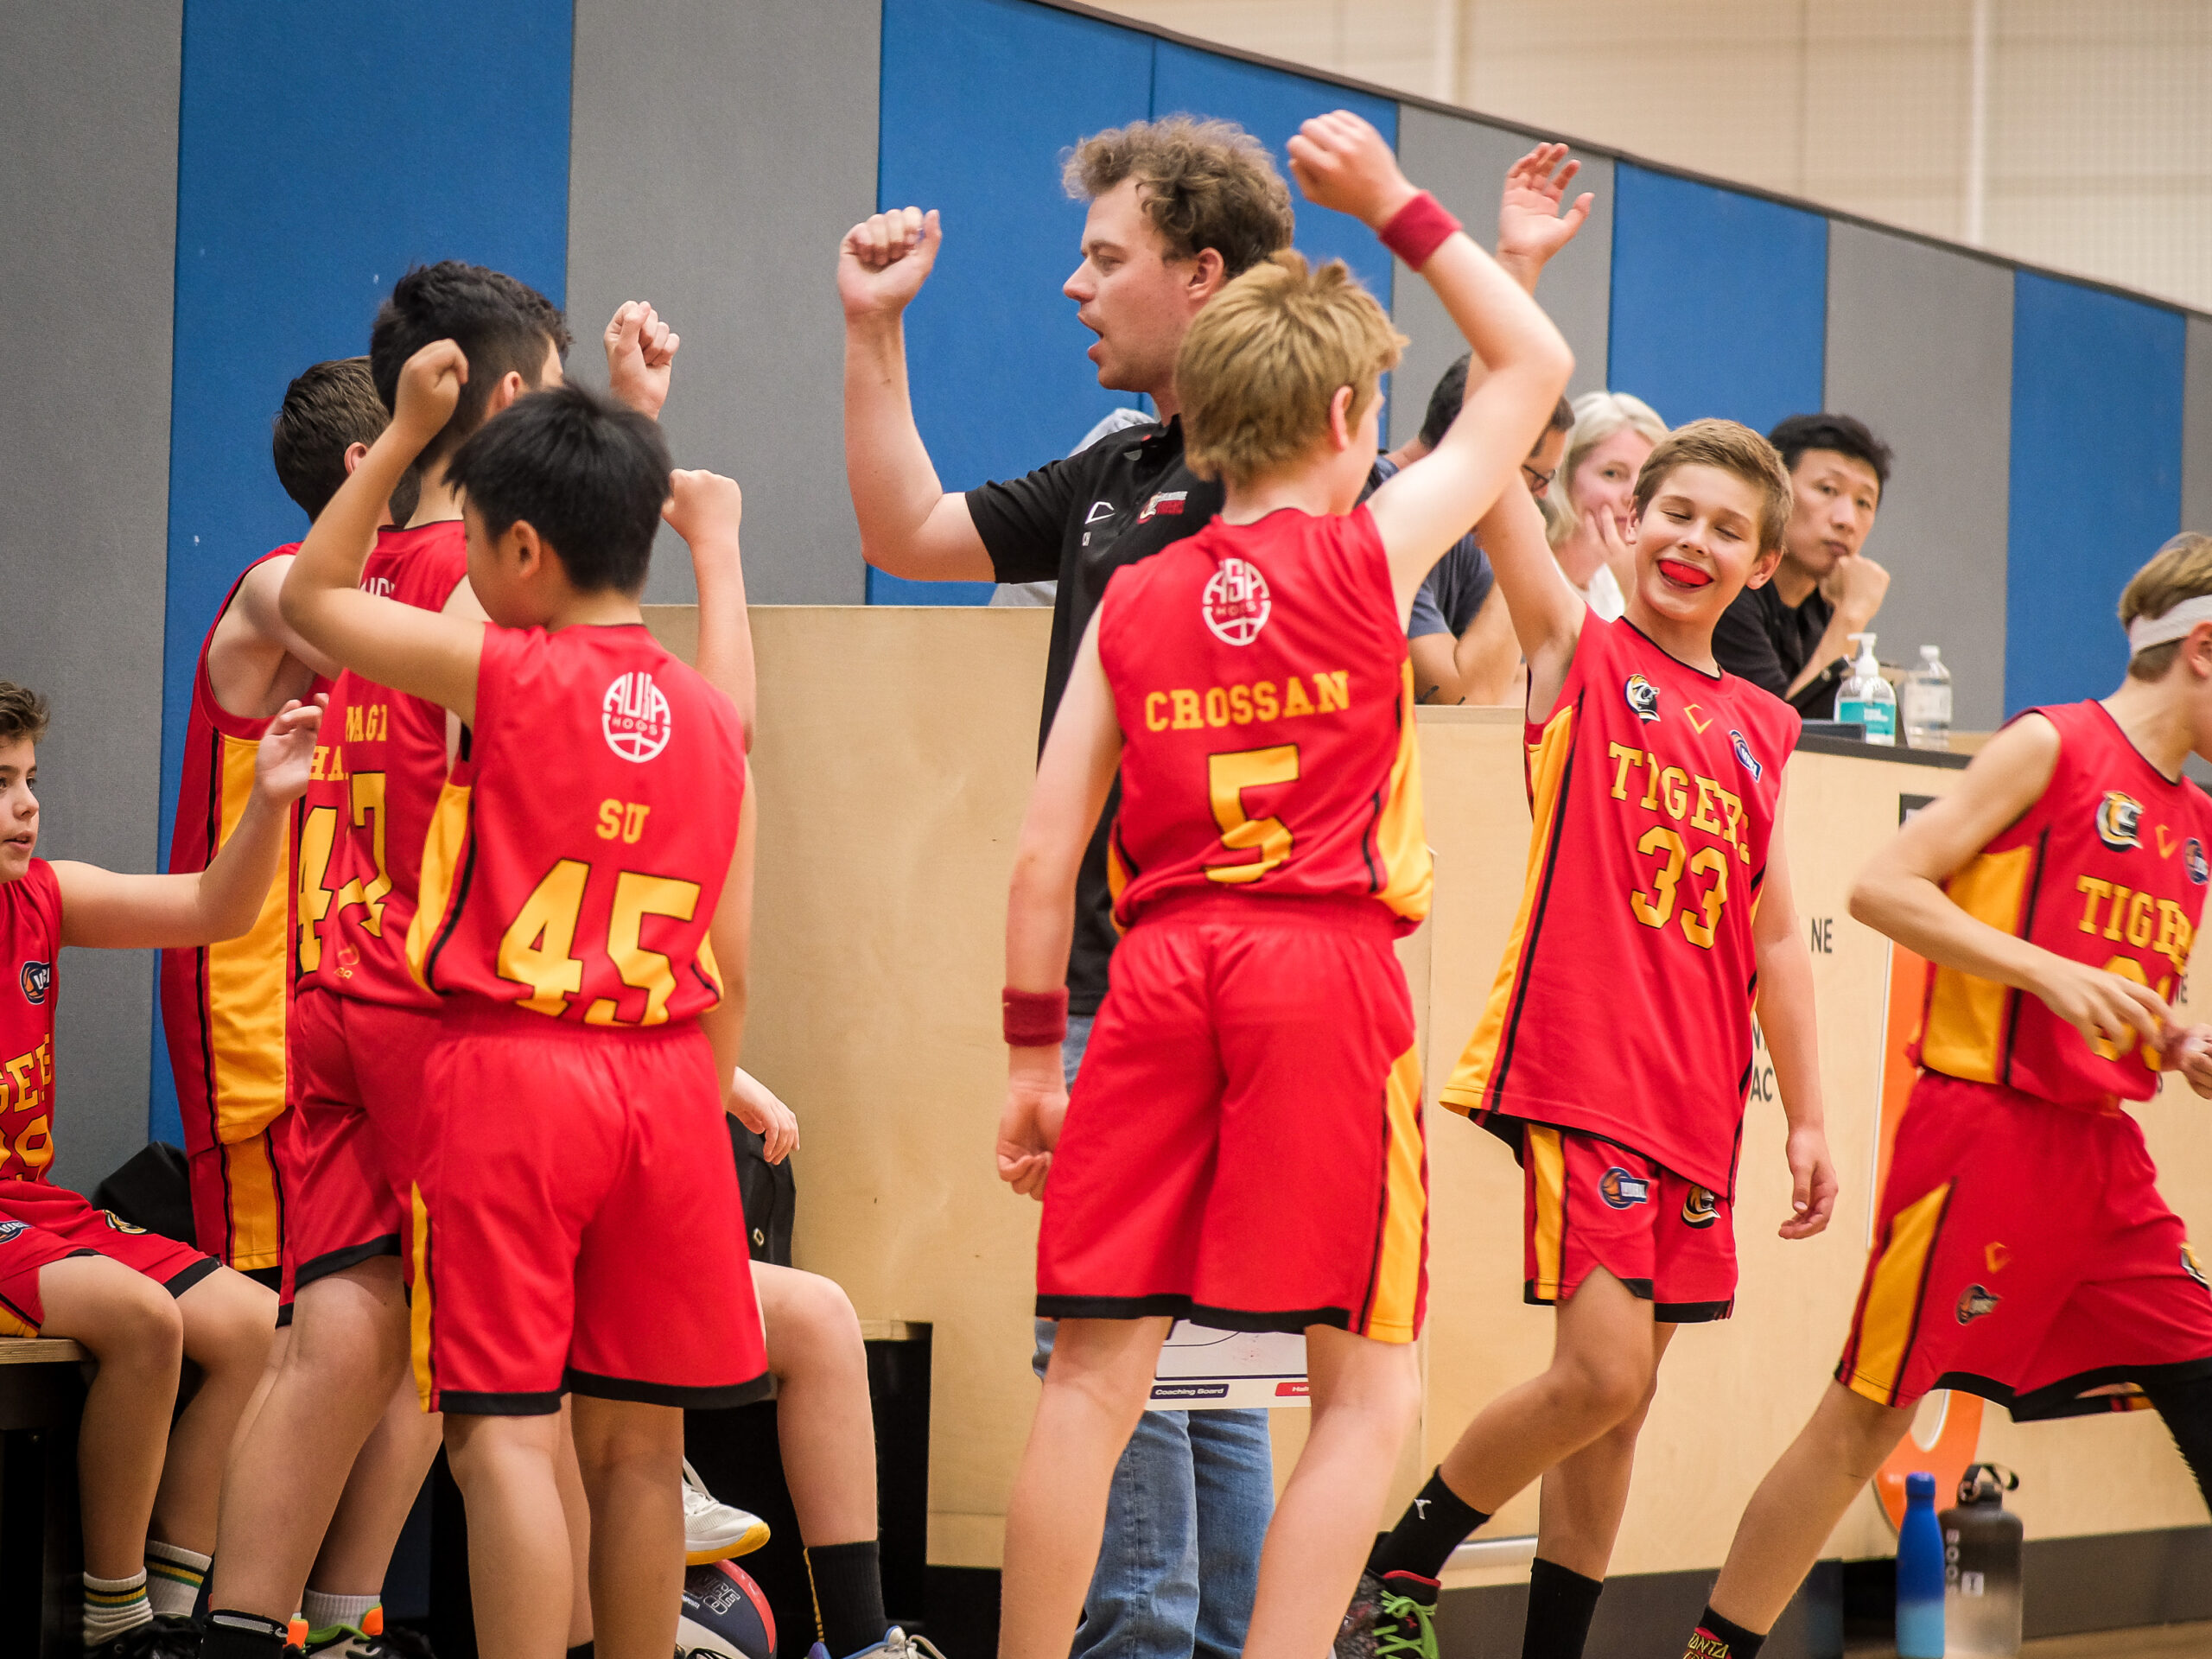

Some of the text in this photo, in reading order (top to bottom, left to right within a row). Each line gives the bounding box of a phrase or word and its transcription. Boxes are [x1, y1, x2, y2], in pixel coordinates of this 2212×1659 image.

[1145, 670, 1350, 732] CROSSAN
[595, 798, 651, 844] SU
[1205, 742, 1300, 884] 5
[495, 855, 702, 1027] 45
[1629, 824, 1729, 950] 33
